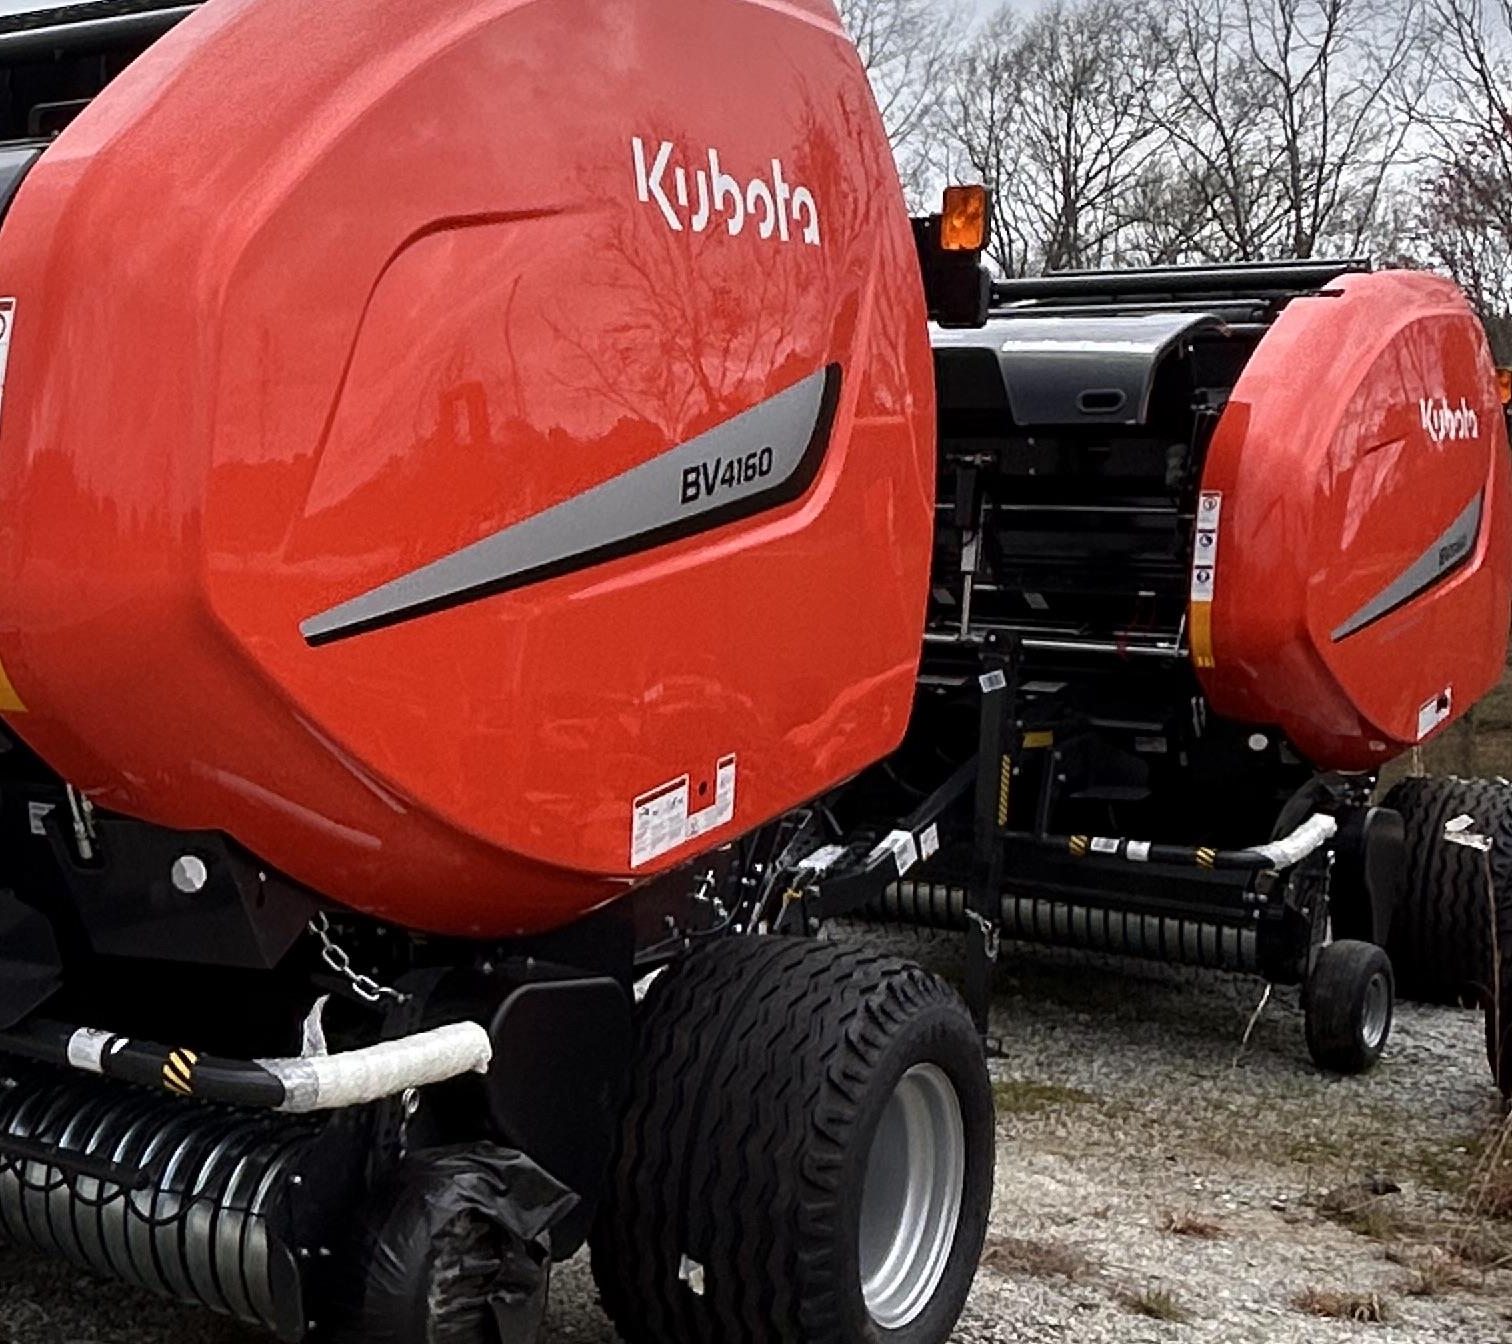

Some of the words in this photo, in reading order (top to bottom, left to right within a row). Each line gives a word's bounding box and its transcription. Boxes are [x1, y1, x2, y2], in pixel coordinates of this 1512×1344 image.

[632, 136, 820, 246] Kubota
[1419, 396, 1479, 442] Kubota
[680, 446, 774, 505] BV4160
